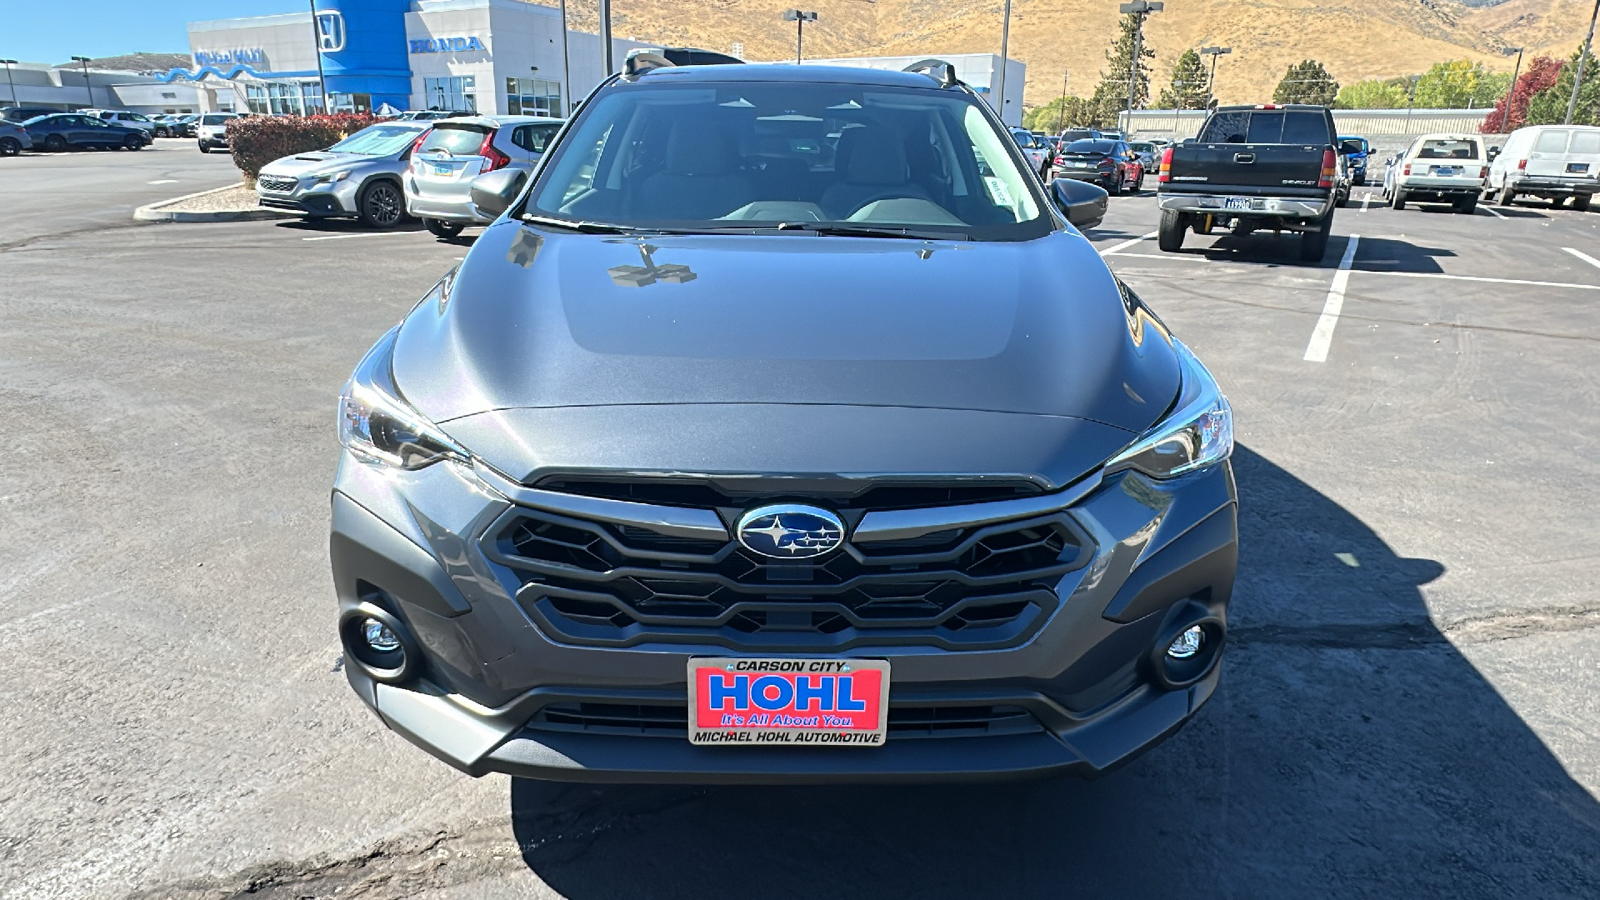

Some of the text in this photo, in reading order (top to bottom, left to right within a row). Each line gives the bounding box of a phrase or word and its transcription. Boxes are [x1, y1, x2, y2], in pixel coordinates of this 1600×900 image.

[409, 36, 485, 54] HONDA
[736, 661, 846, 672] CARSON CITY
[709, 674, 866, 712] HOHL
[721, 714, 853, 726] It's All About You.
[694, 731, 881, 743] MICHAEL HOHL AUTOMOTIVE
